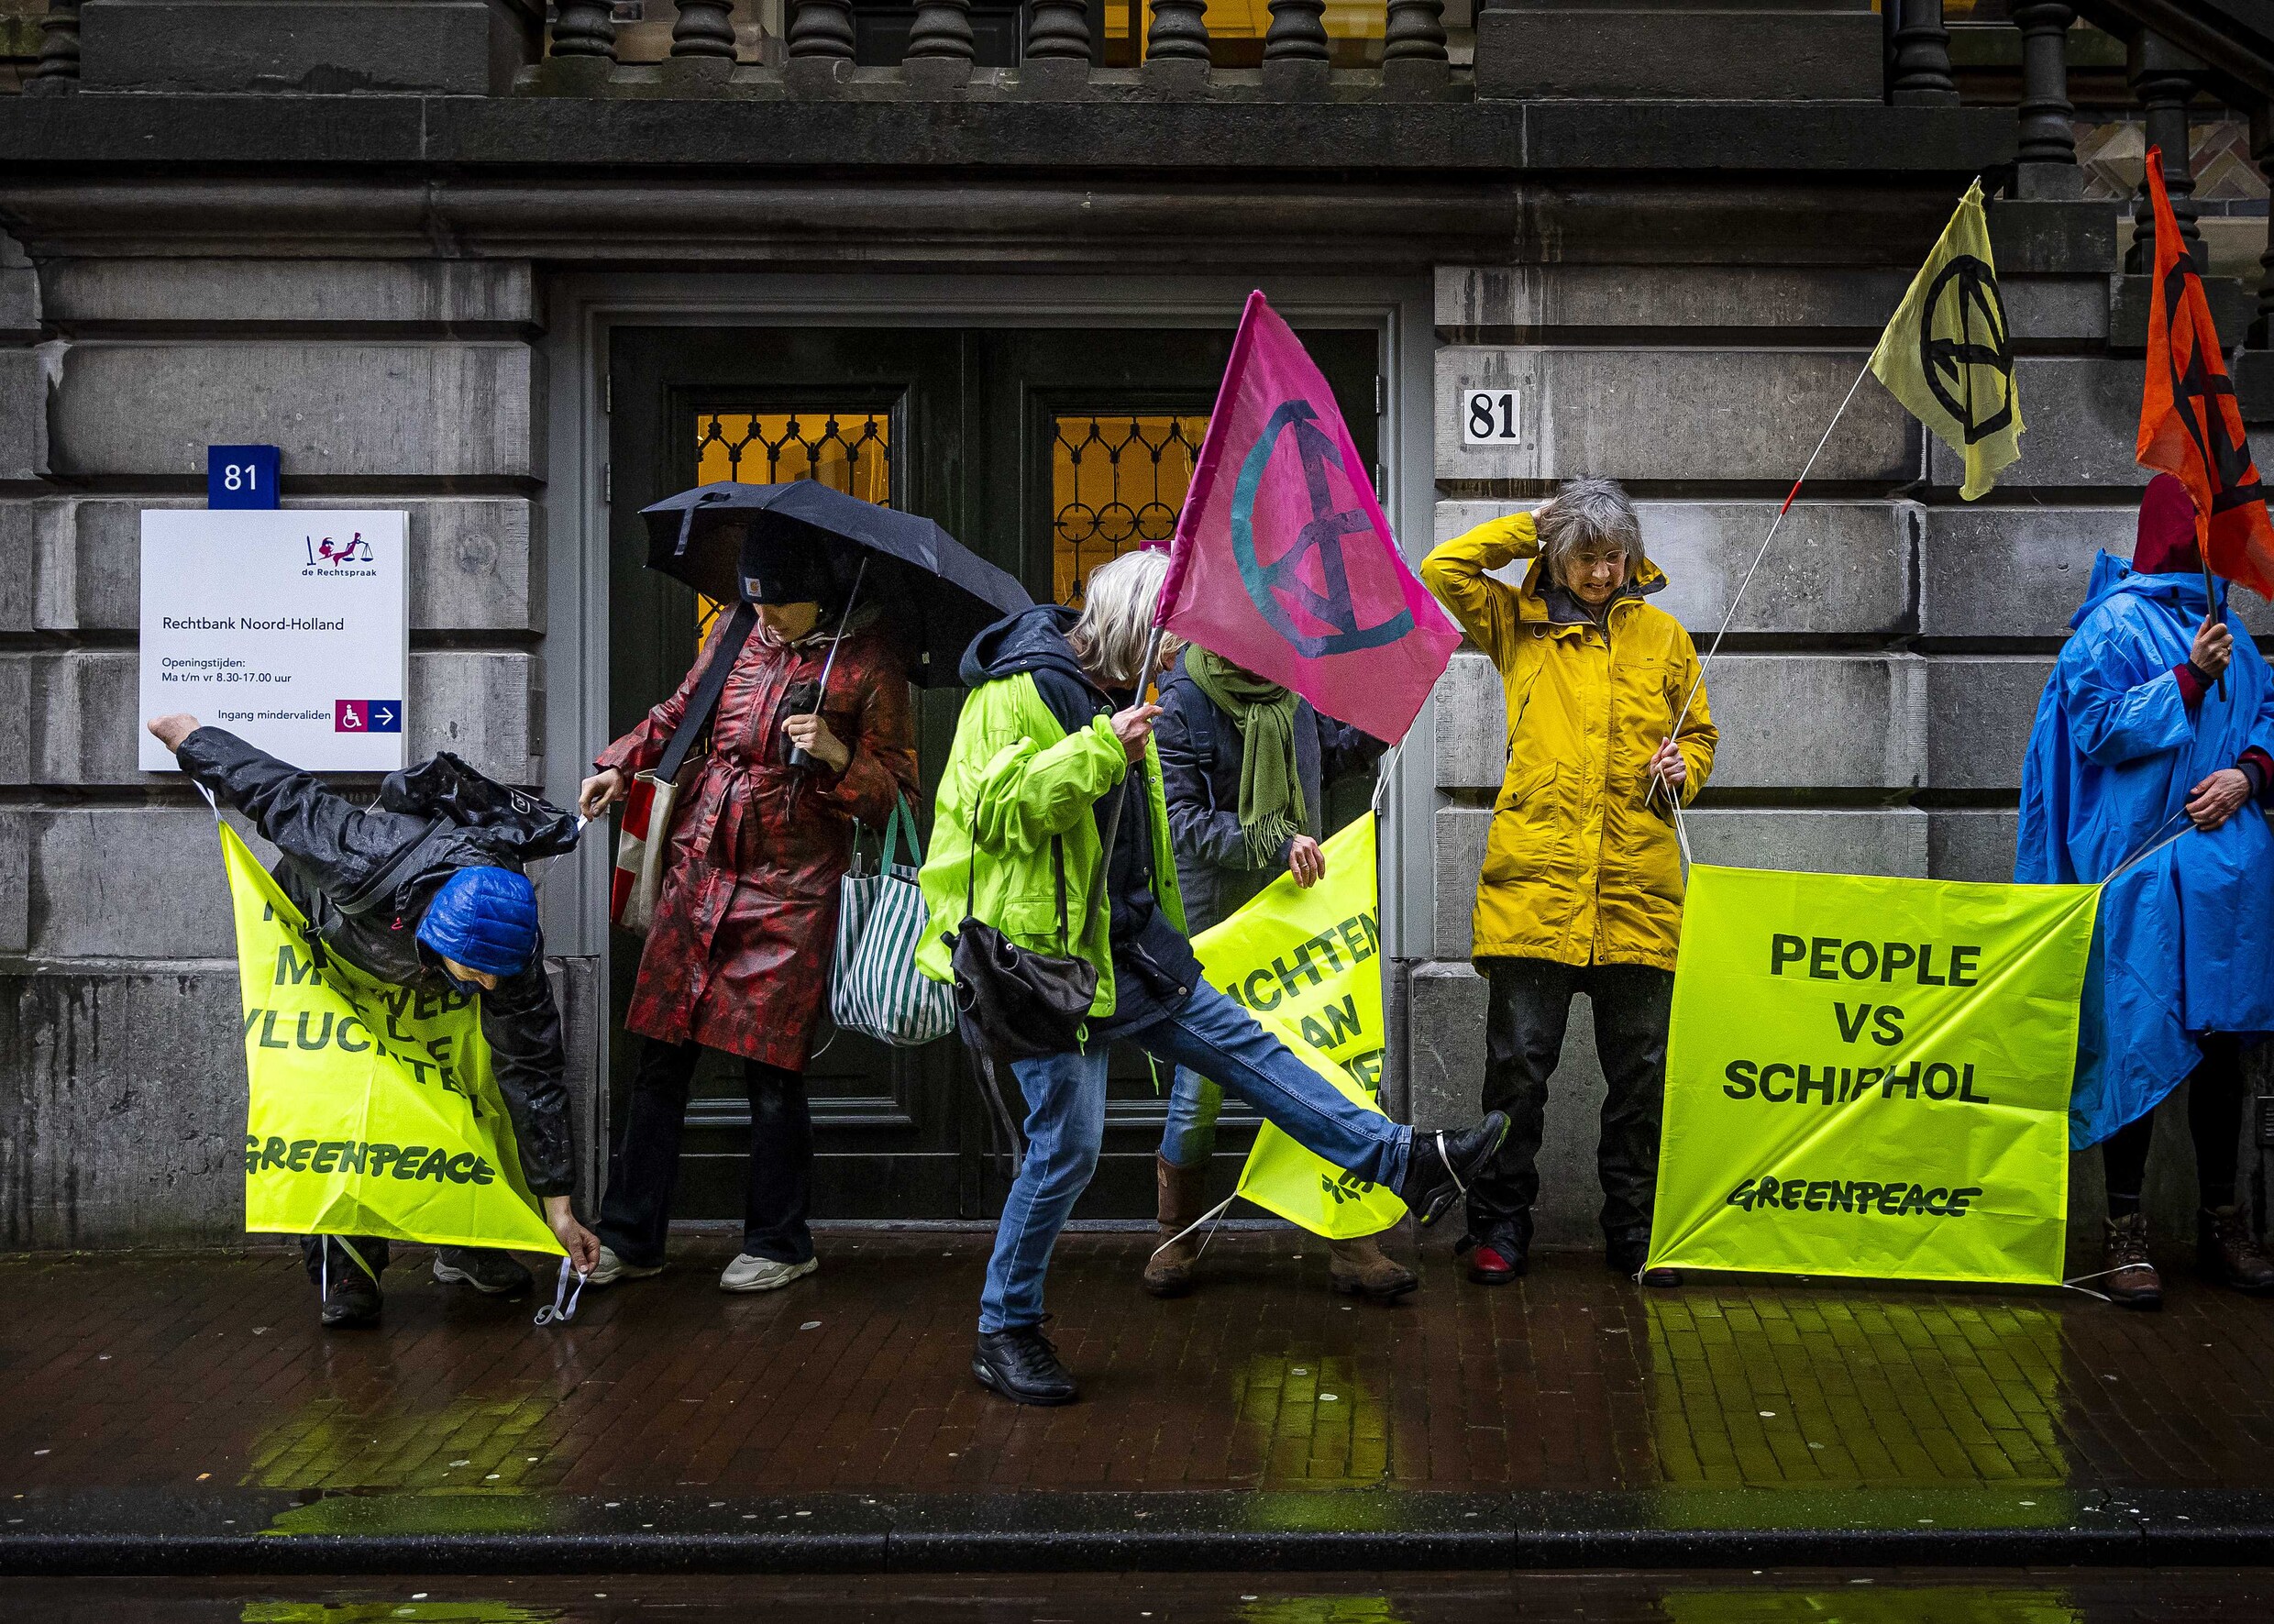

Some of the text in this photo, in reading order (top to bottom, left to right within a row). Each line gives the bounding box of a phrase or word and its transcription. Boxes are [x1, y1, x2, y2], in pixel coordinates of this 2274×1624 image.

[1469, 393, 1516, 438] 81
[224, 464, 256, 491] 81
[302, 567, 377, 578] de Rechtspraak
[162, 616, 345, 631] Rechtbank Noord-Holland
[162, 657, 246, 670] Openingstijden:
[162, 672, 179, 682] Ma
[182, 672, 200, 682] t/m
[216, 673, 271, 682] 8.30-17.00
[218, 709, 331, 723] Ingang mindervaliden
[1771, 934, 1981, 987] PEOPLE
[1834, 1001, 1905, 1046] VS
[1723, 1060, 1990, 1106] SCHIPHOL
[245, 1134, 496, 1186] GREENPEACE
[1727, 1176, 1982, 1218] GREENPEACE
